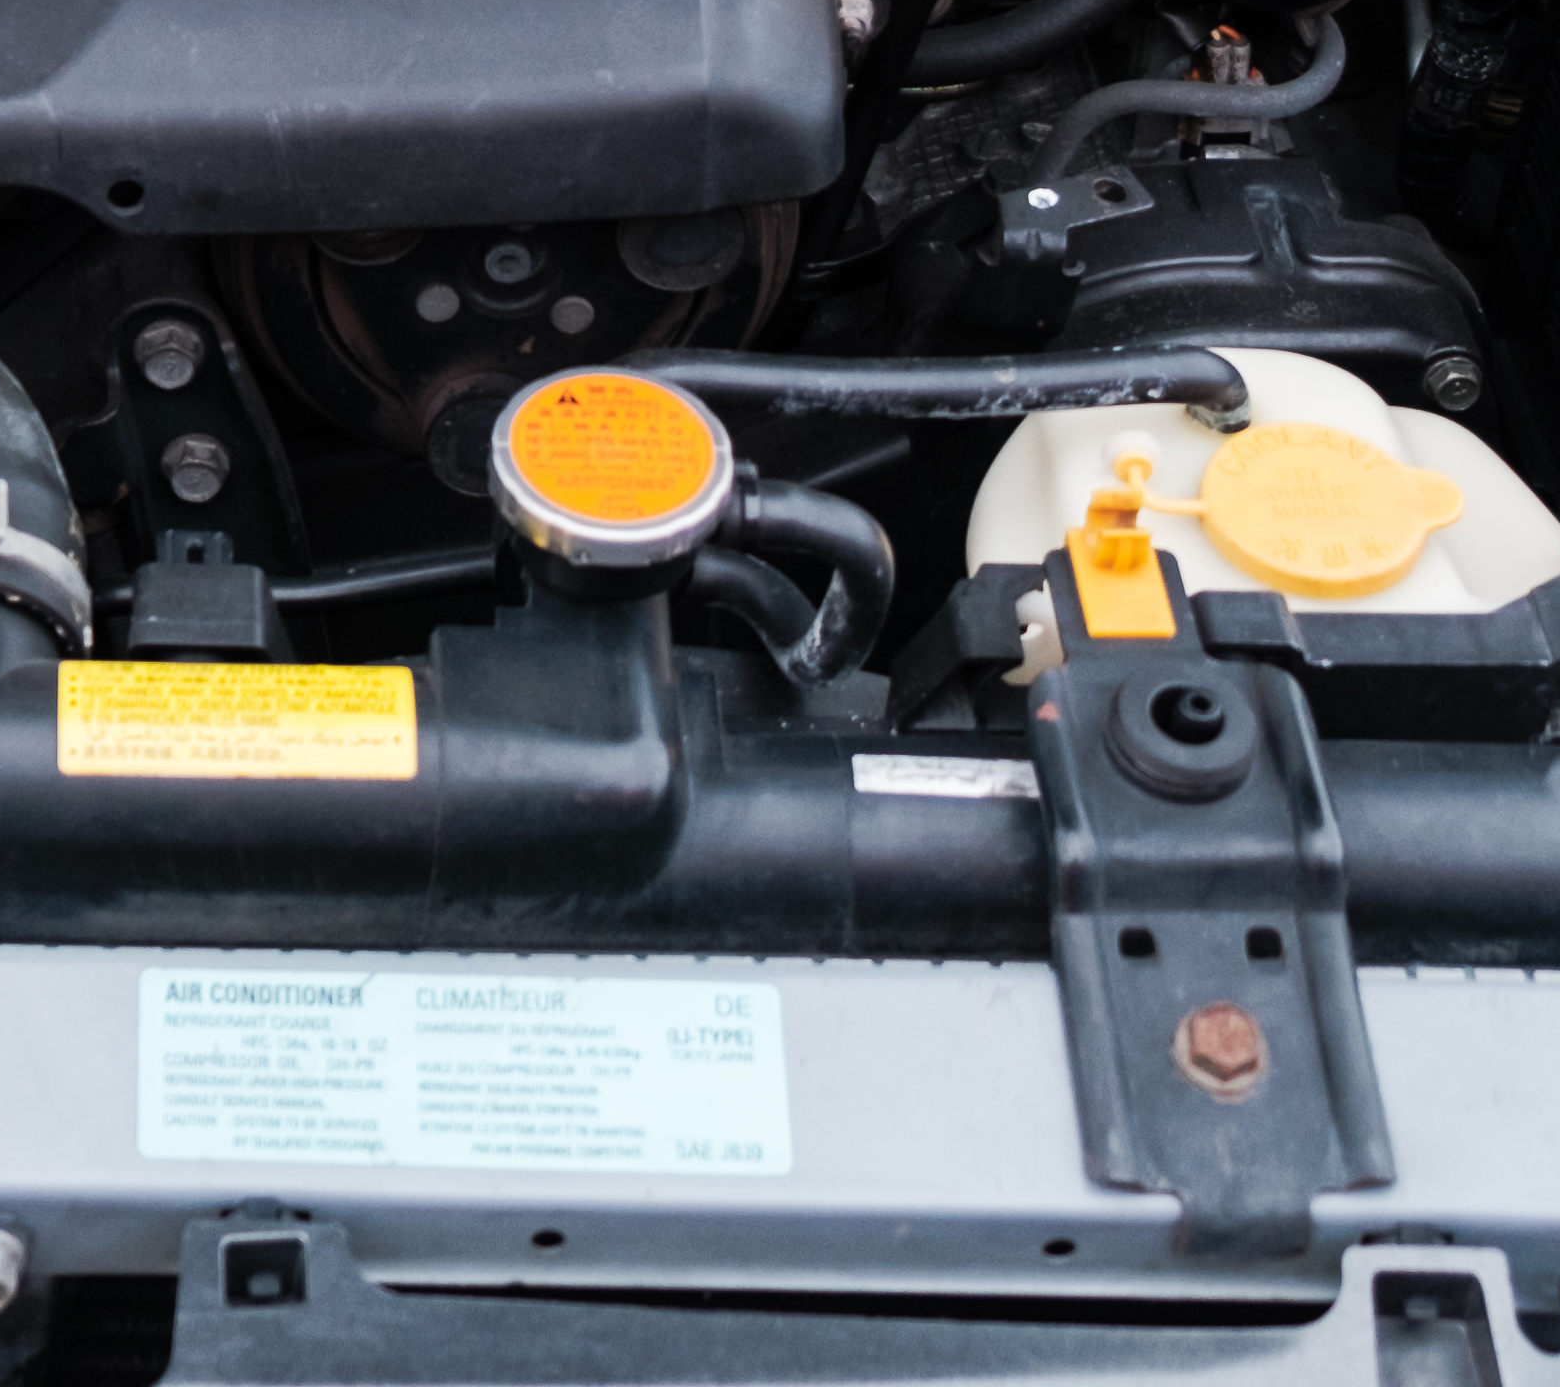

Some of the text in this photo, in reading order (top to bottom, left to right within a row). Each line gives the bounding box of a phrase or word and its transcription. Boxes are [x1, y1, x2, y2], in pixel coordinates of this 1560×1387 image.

[1216, 426, 1392, 477] COOLANT
[165, 981, 364, 1007] AIR CONDITIONER
[416, 986, 566, 1013] CLIMATISEUR
[713, 993, 753, 1018] DE
[674, 1138, 713, 1163] SAE
